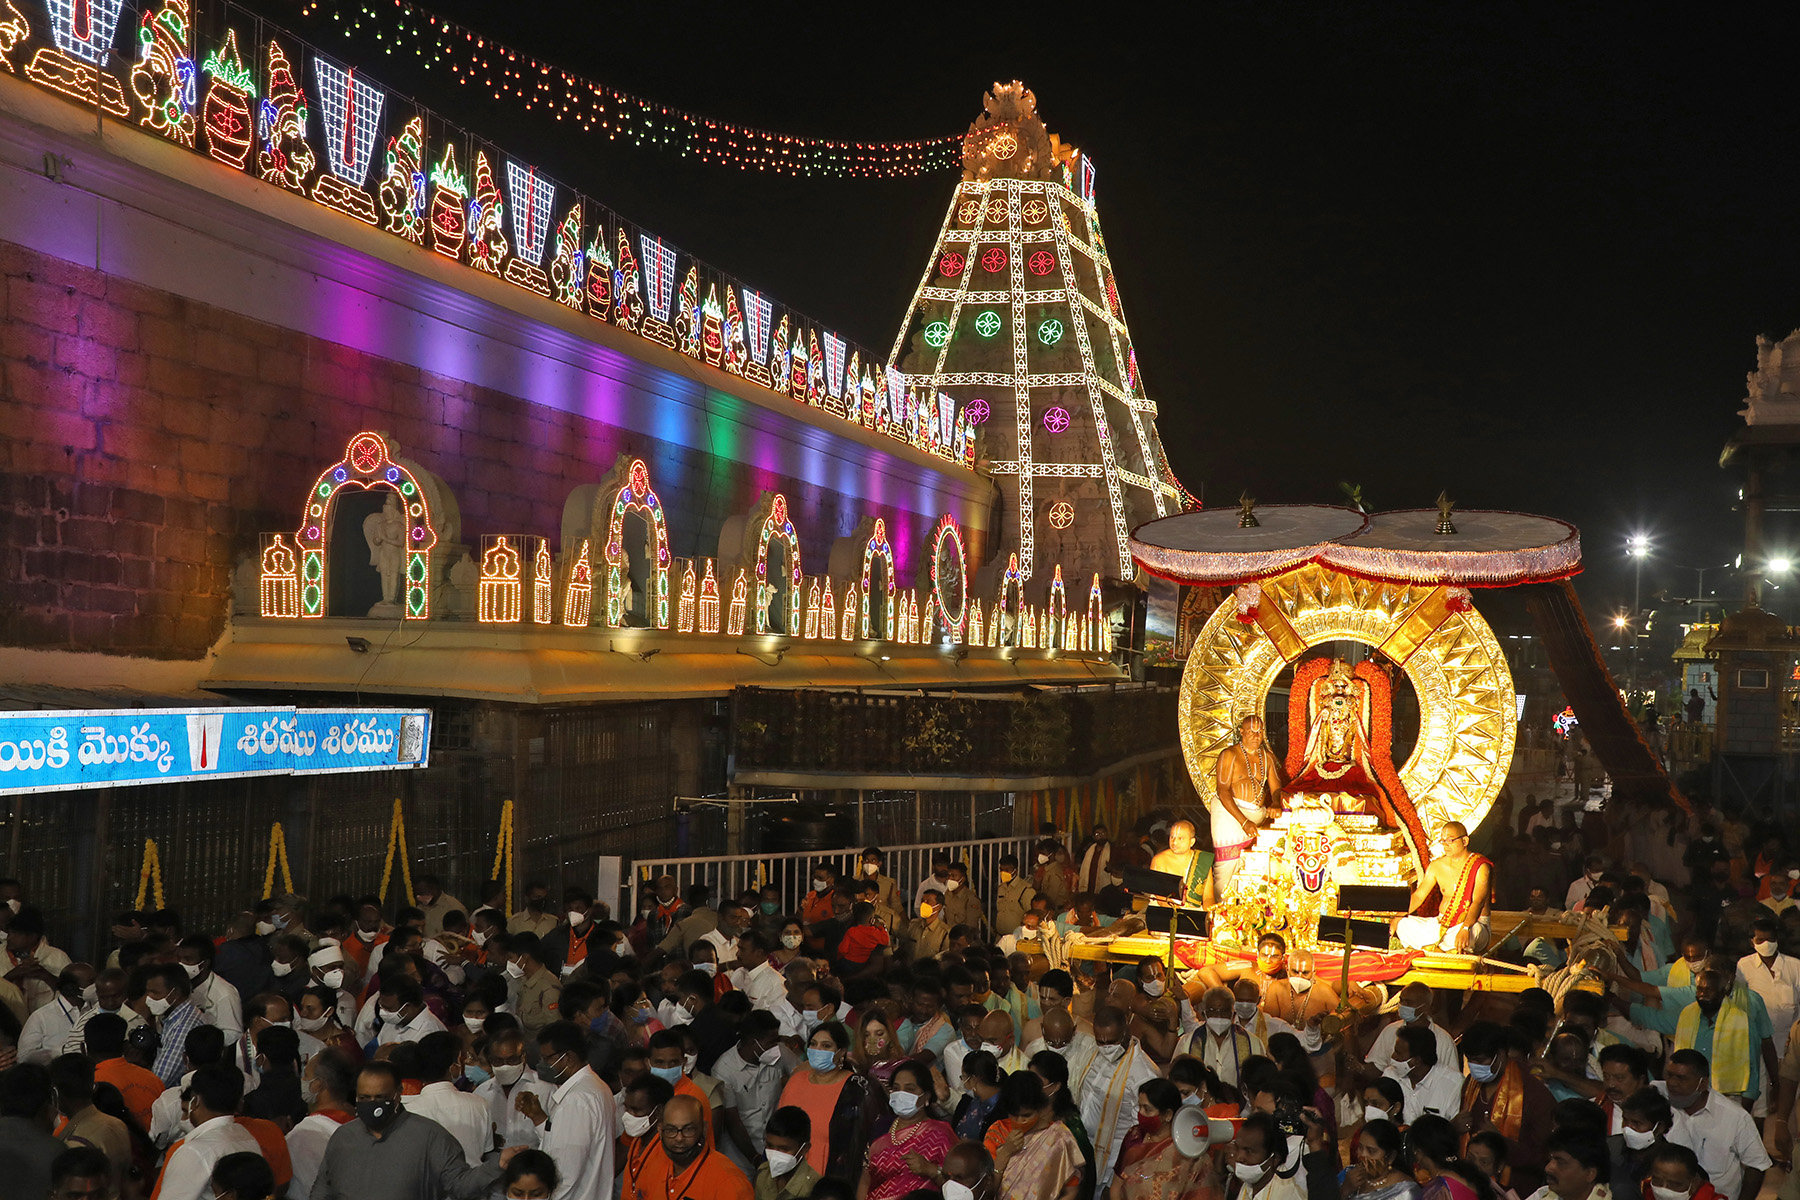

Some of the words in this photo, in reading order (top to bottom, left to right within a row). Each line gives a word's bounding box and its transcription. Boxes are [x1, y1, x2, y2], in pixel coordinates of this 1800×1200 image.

[78, 722, 175, 773] మొక్కు
[236, 716, 317, 757] శిరము
[321, 716, 395, 756] శిరము
